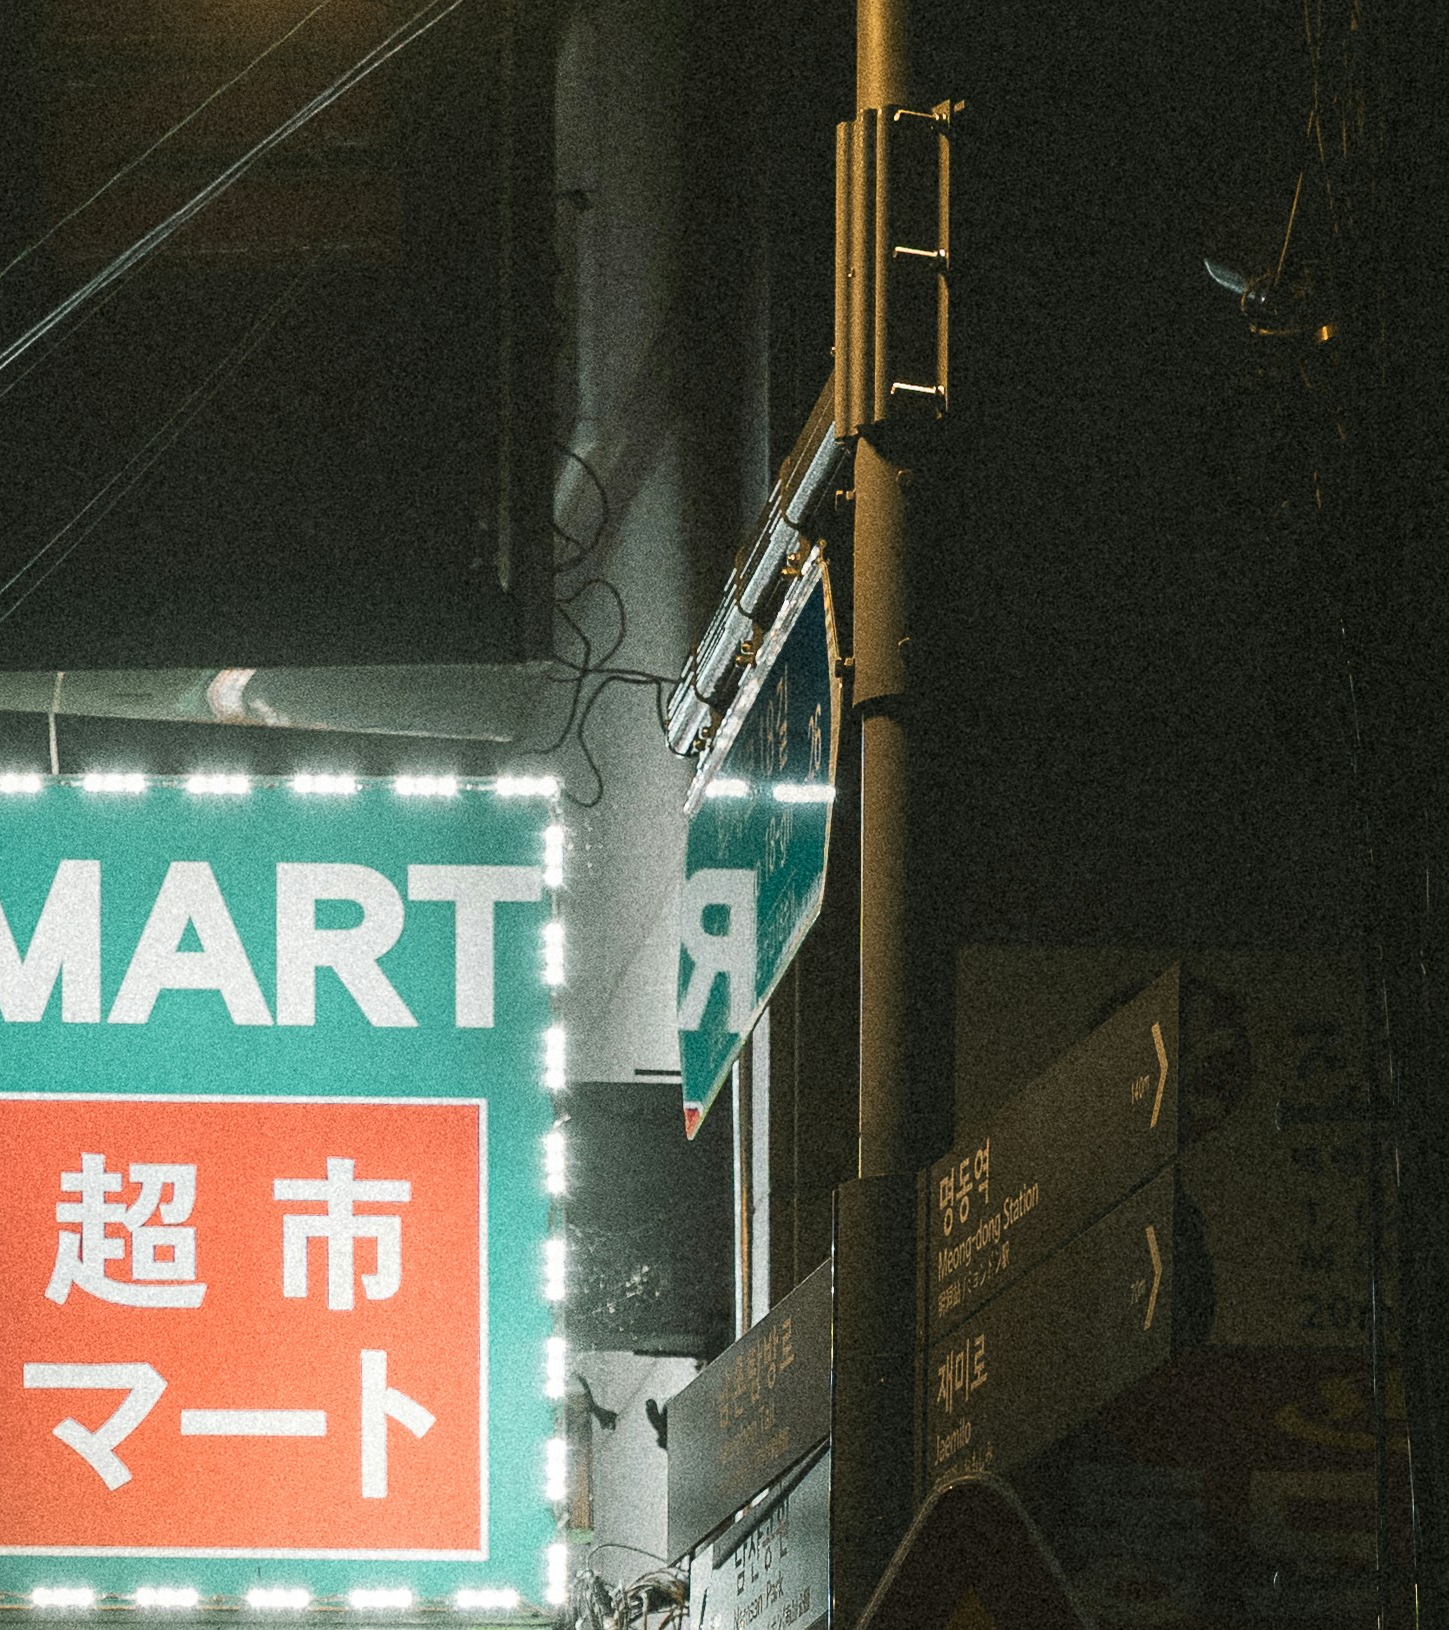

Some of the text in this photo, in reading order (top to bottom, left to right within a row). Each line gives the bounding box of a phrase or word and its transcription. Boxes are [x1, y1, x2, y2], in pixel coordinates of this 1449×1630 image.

[43, 1151, 412, 1311] 超市
[938, 1135, 991, 1237] 명동역
[1002, 1183, 1040, 1231] Station
[22, 1348, 437, 1500] マート
[936, 1332, 989, 1414] 재미로
